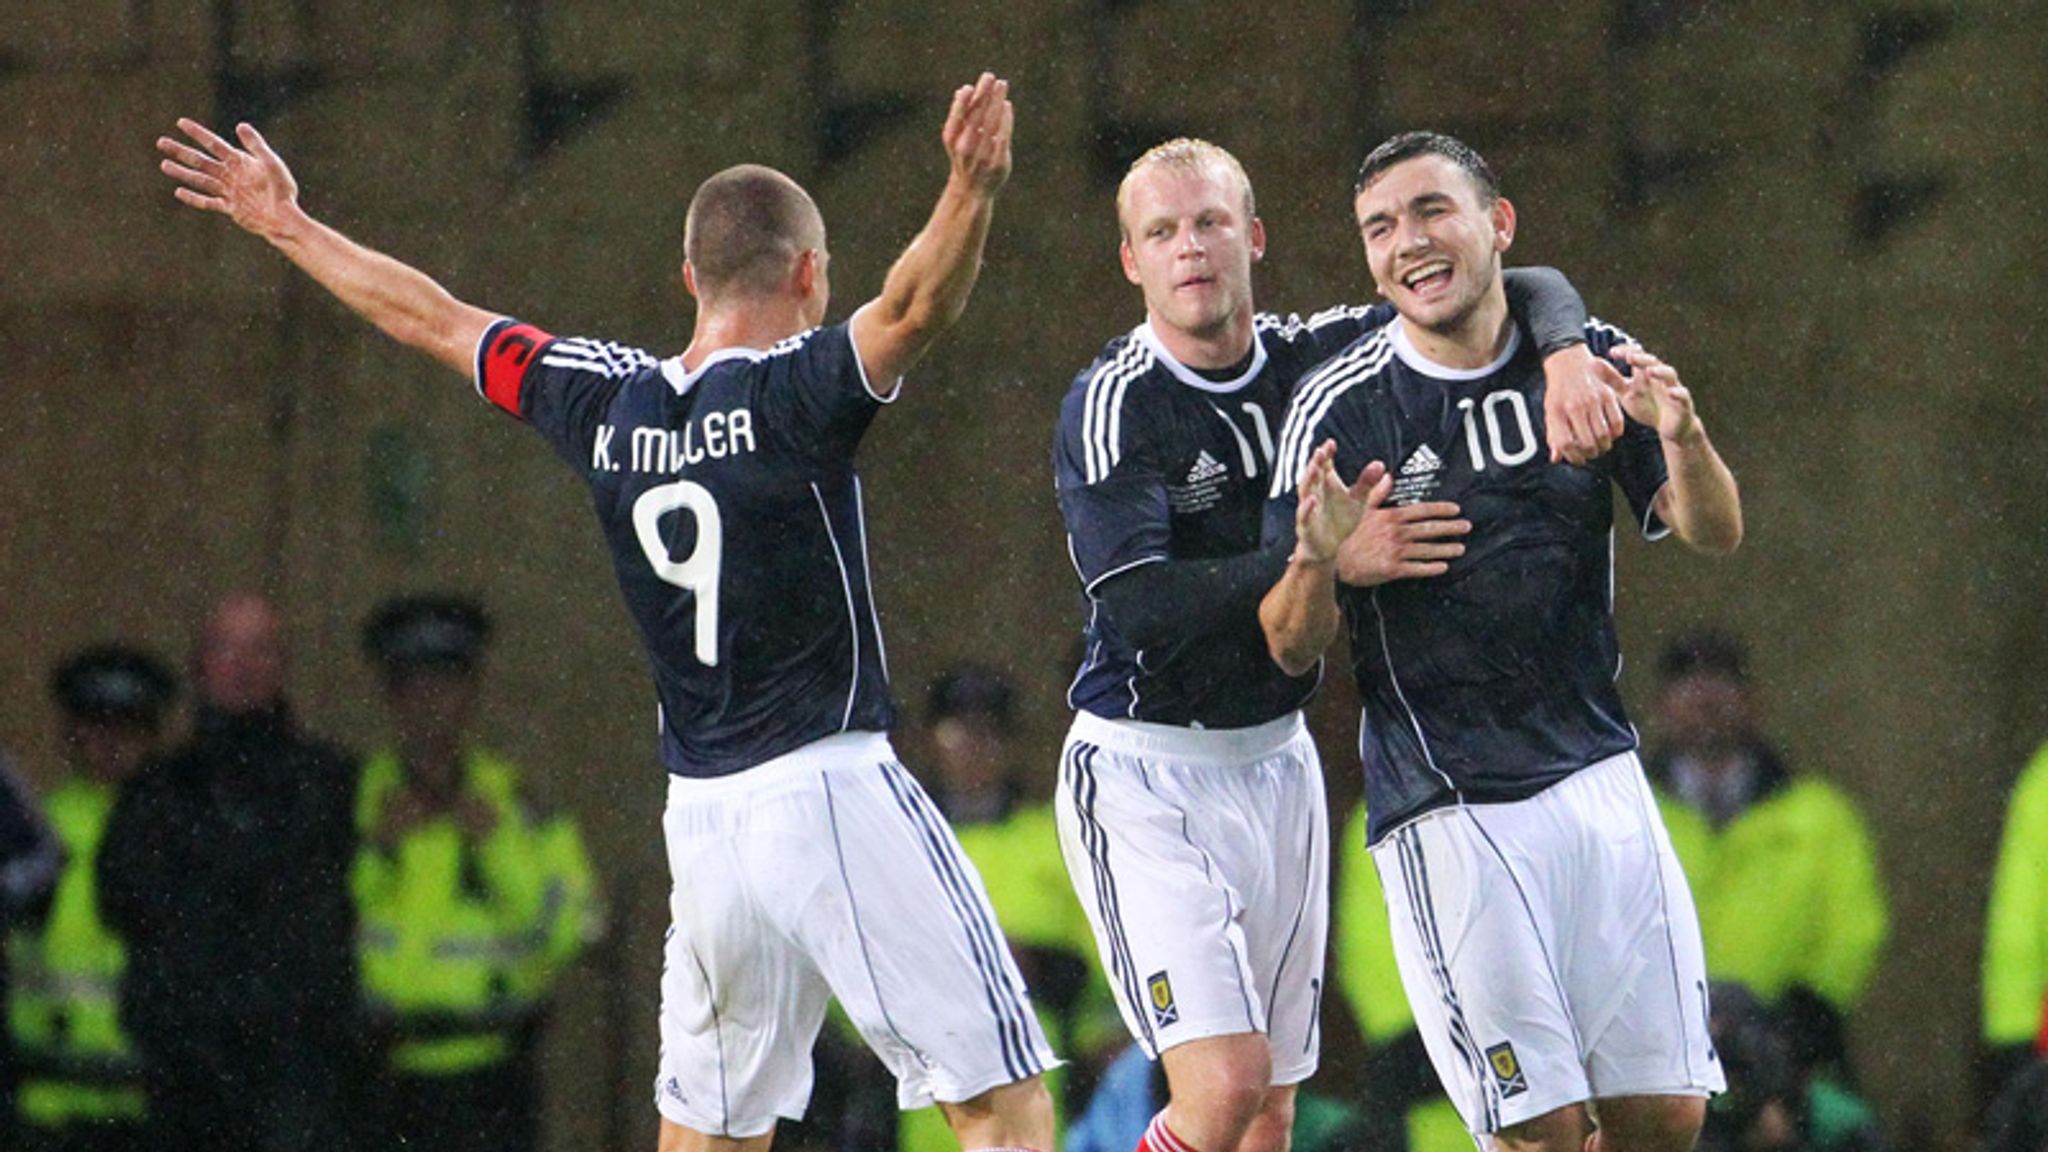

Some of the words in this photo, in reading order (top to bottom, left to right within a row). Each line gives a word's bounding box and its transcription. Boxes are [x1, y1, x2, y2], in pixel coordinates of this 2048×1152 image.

[593, 425, 621, 472] K.
[632, 409, 756, 474] MILER
[1457, 389, 1538, 472] 10
[632, 479, 722, 667] 9
